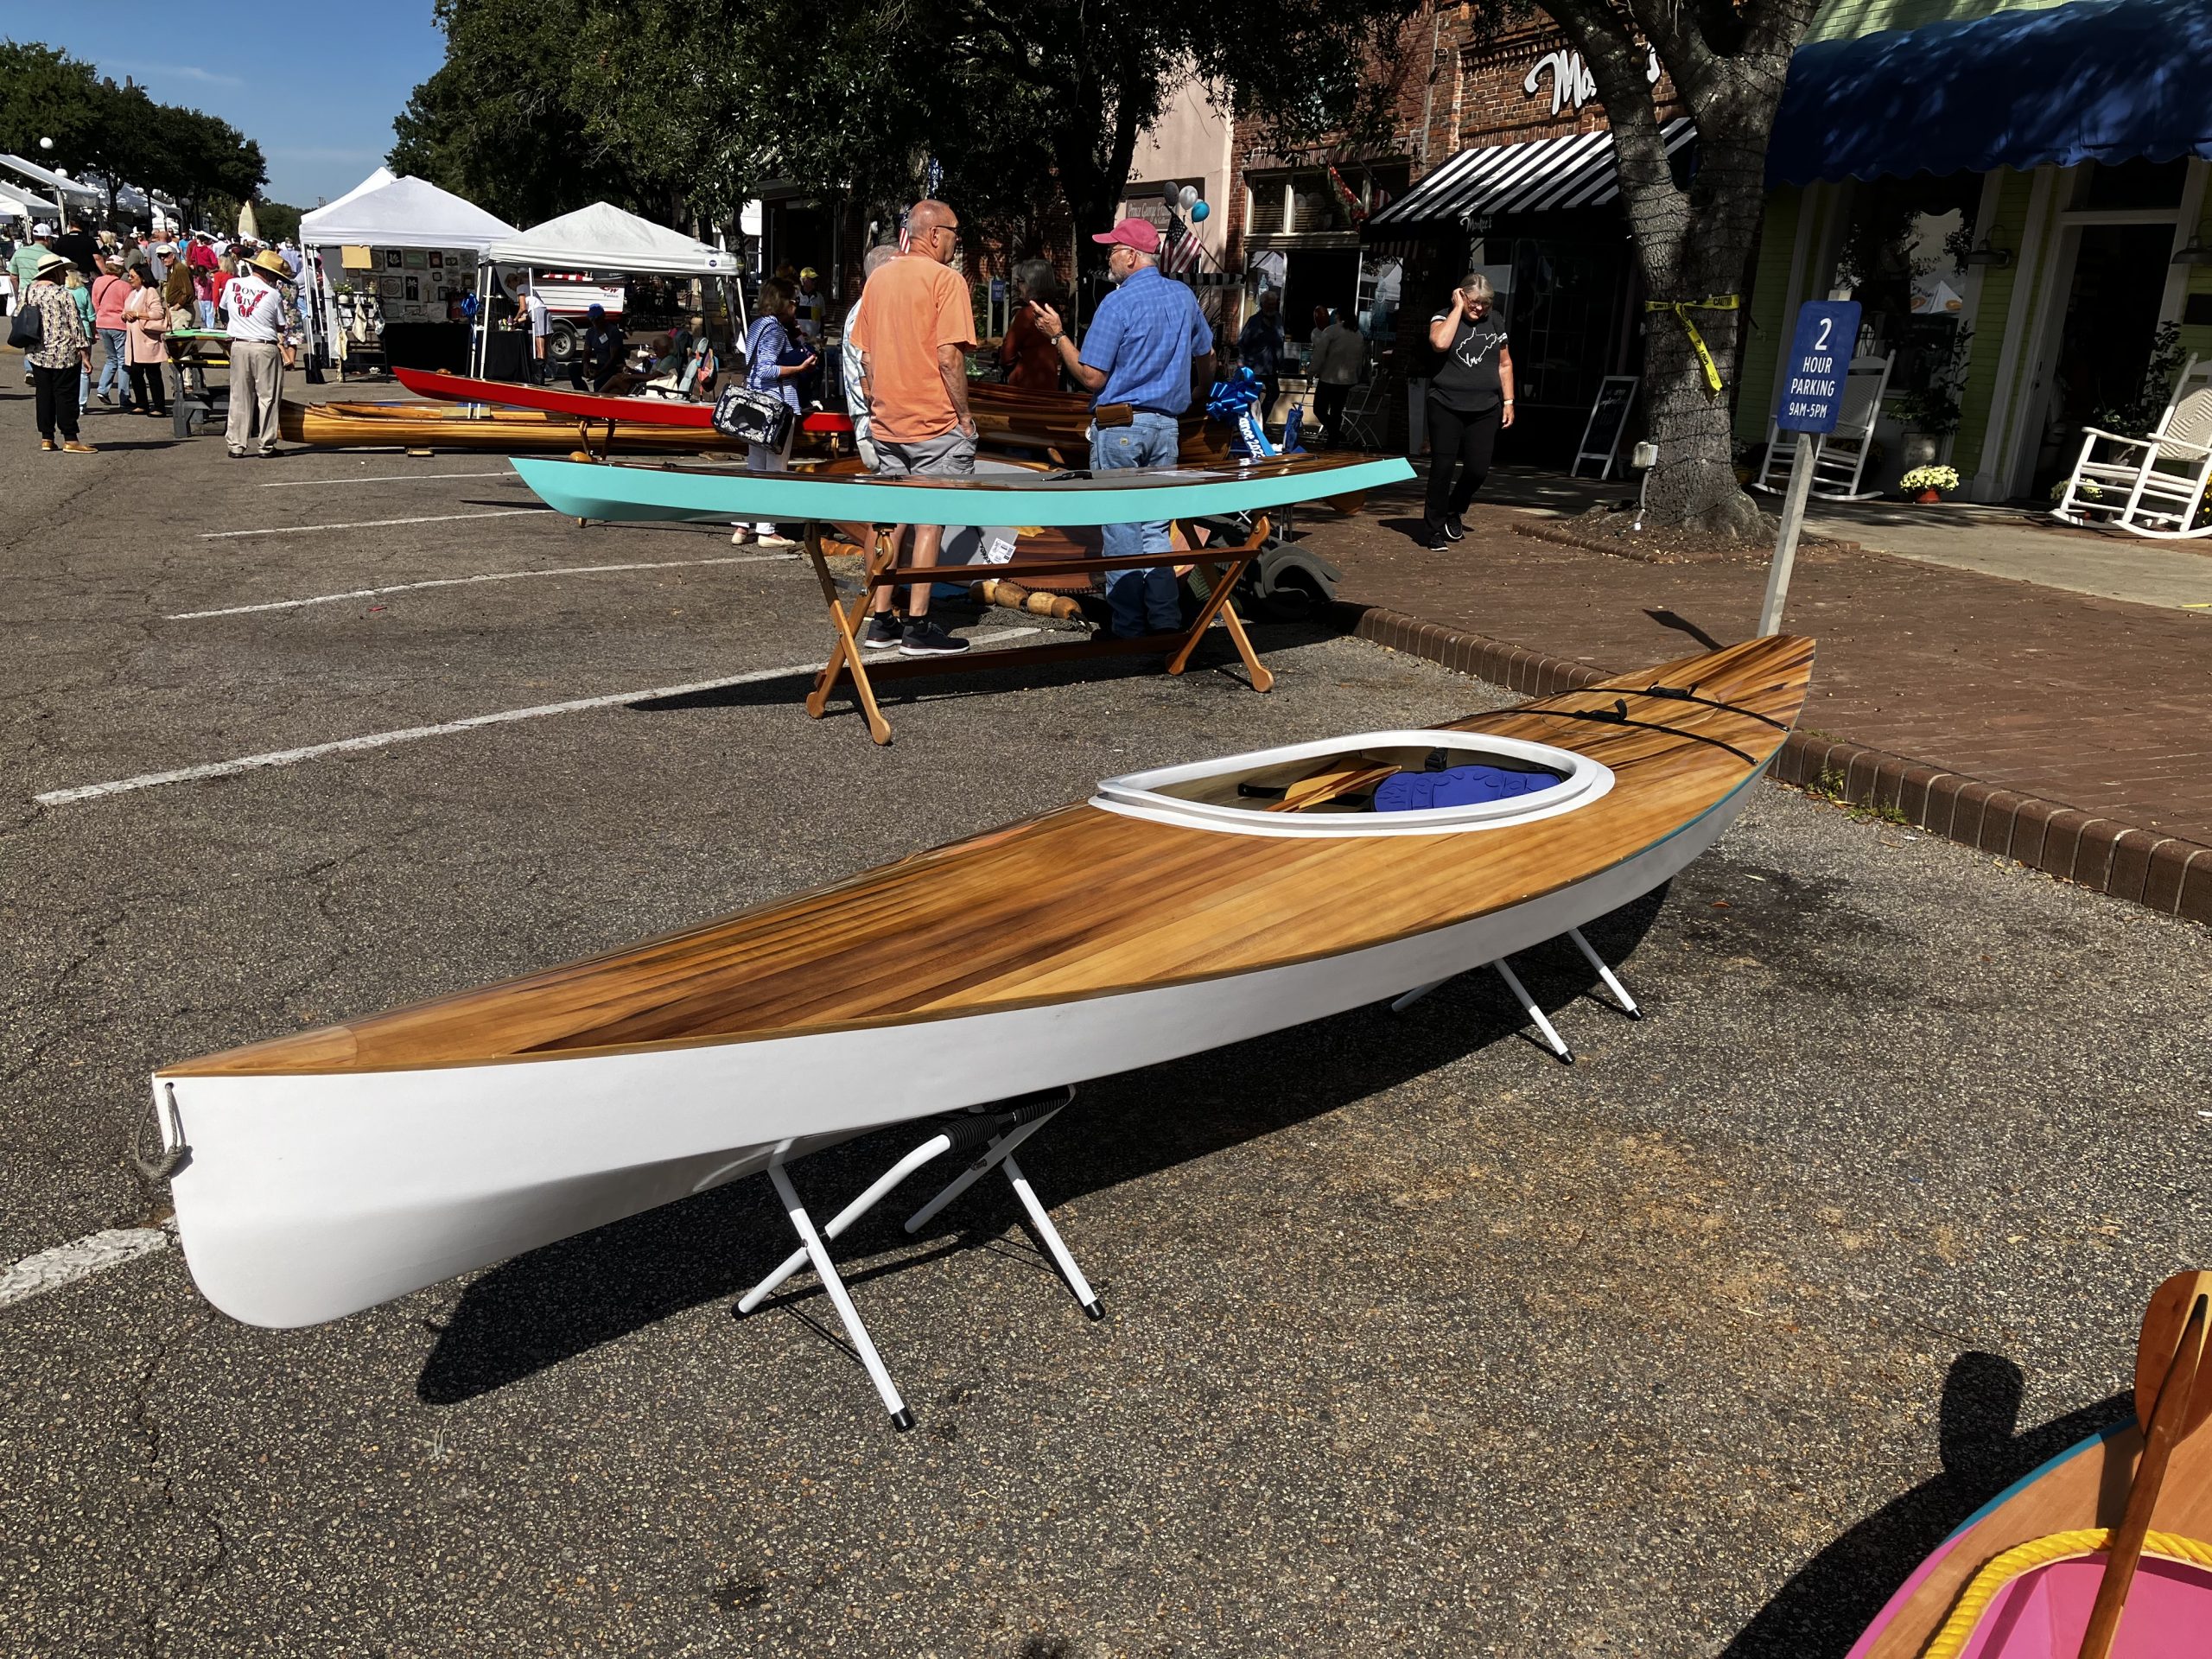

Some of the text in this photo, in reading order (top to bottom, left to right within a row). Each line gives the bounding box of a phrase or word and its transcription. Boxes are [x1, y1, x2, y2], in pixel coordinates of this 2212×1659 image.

[1815, 317, 1833, 351] 2
[1802, 356, 1833, 373] HOUR
[1790, 378, 1835, 397] PARKING
[1789, 402, 1827, 418] 9AM-5PM
